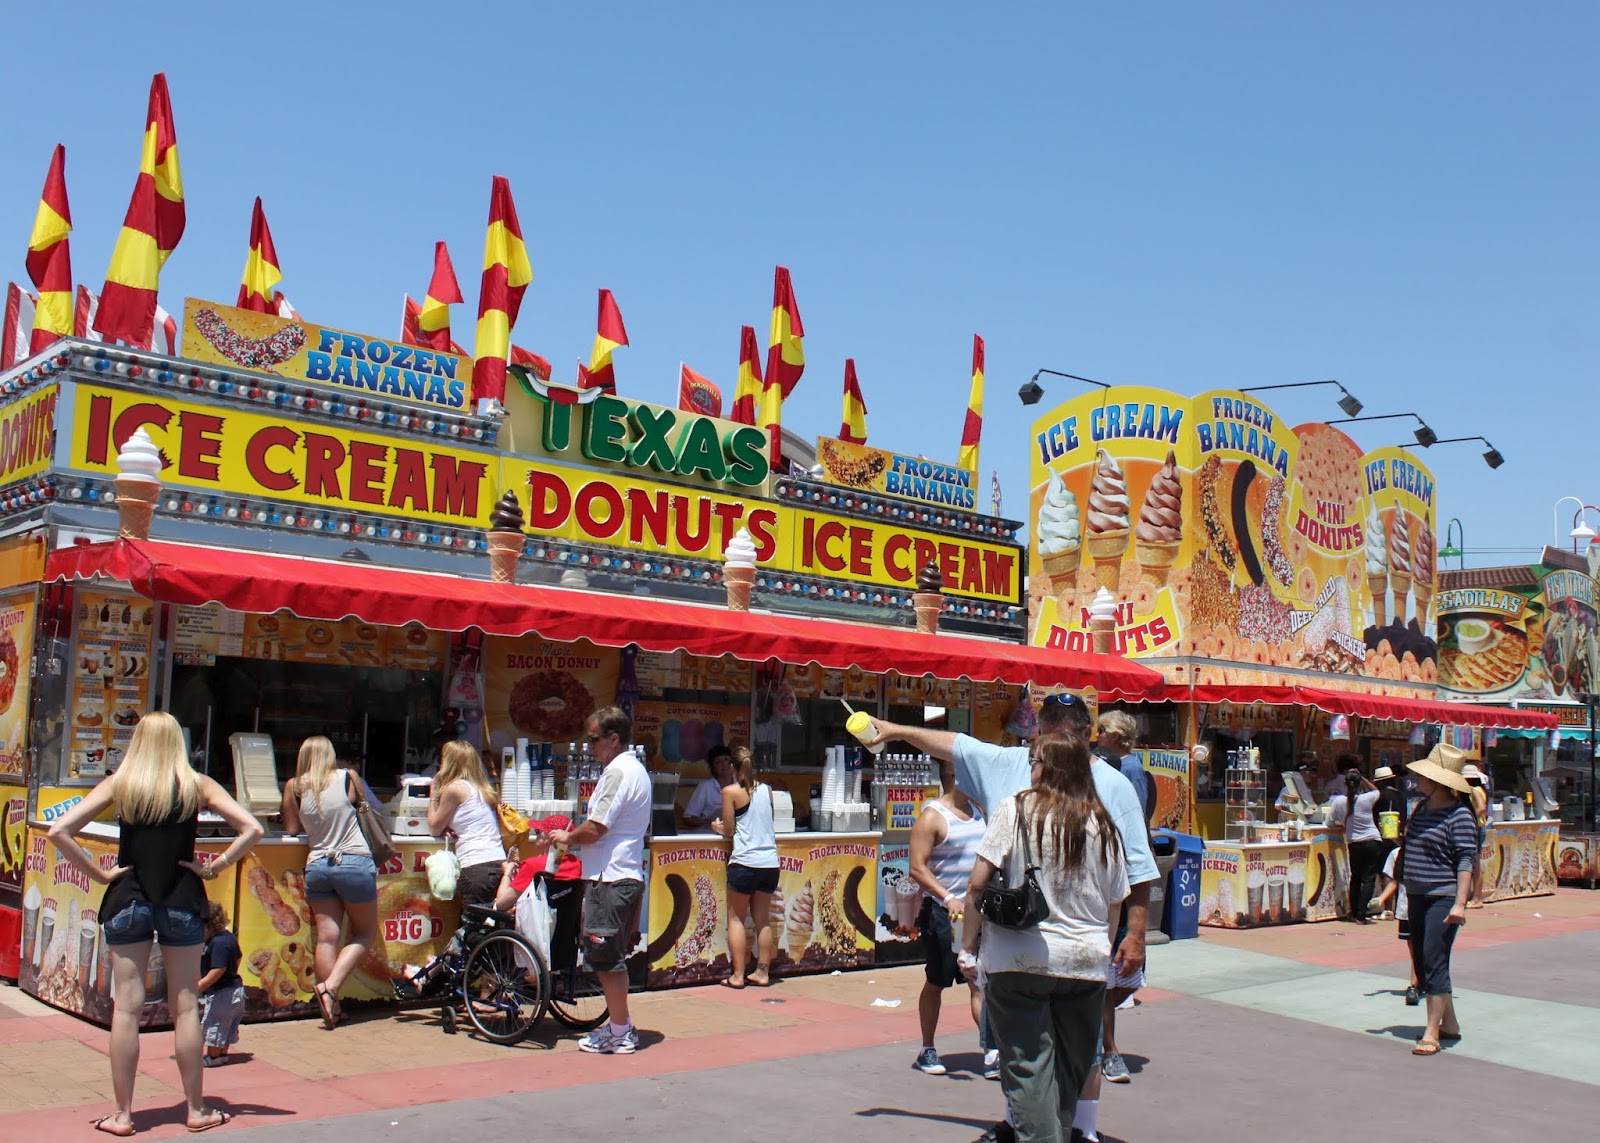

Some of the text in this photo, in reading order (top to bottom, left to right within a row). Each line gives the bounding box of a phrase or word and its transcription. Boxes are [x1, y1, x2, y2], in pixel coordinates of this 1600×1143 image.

[318, 329, 459, 379] FROZEN
[306, 349, 466, 410] BANANAS
[1212, 397, 1273, 434] FROZEN
[0, 392, 56, 478] DONUTS
[543, 396, 769, 487] TEXAS
[1037, 403, 1184, 465] ICE CREAM
[1196, 421, 1288, 479] BANANA
[85, 393, 488, 520] ICE CREAM
[892, 454, 971, 487] FROZEN
[885, 470, 976, 509] BANANAS
[1364, 457, 1434, 504] ICE CREAM
[526, 470, 778, 563] DONUTS
[1316, 499, 1346, 525] MINI
[1294, 508, 1364, 551] DONUTS
[801, 517, 1015, 596] ICE CREAM
[1545, 571, 1594, 604] FISH TACOS
[1289, 575, 1337, 634] DEEP FRIED
[507, 654, 601, 669] BACON DONUT
[1331, 629, 1367, 662] SNICKERS
[667, 708, 724, 717] COTTON CANDY
[1149, 752, 1187, 773] BANANA
[887, 788, 924, 802] REESE'S
[892, 804, 914, 816] DEEP
[658, 848, 696, 866] FROZEN
[809, 844, 876, 861] FROZEN BANANA
[1215, 852, 1239, 863] FRIED
[1245, 862, 1265, 872] COCOA
[1249, 853, 1261, 861] HOT
[1288, 850, 1306, 859] MOCHA
[53, 859, 90, 894] SNICKERS
[1265, 865, 1288, 877] COFFEE
[385, 918, 444, 942] BIG D
[396, 911, 412, 920] THE
